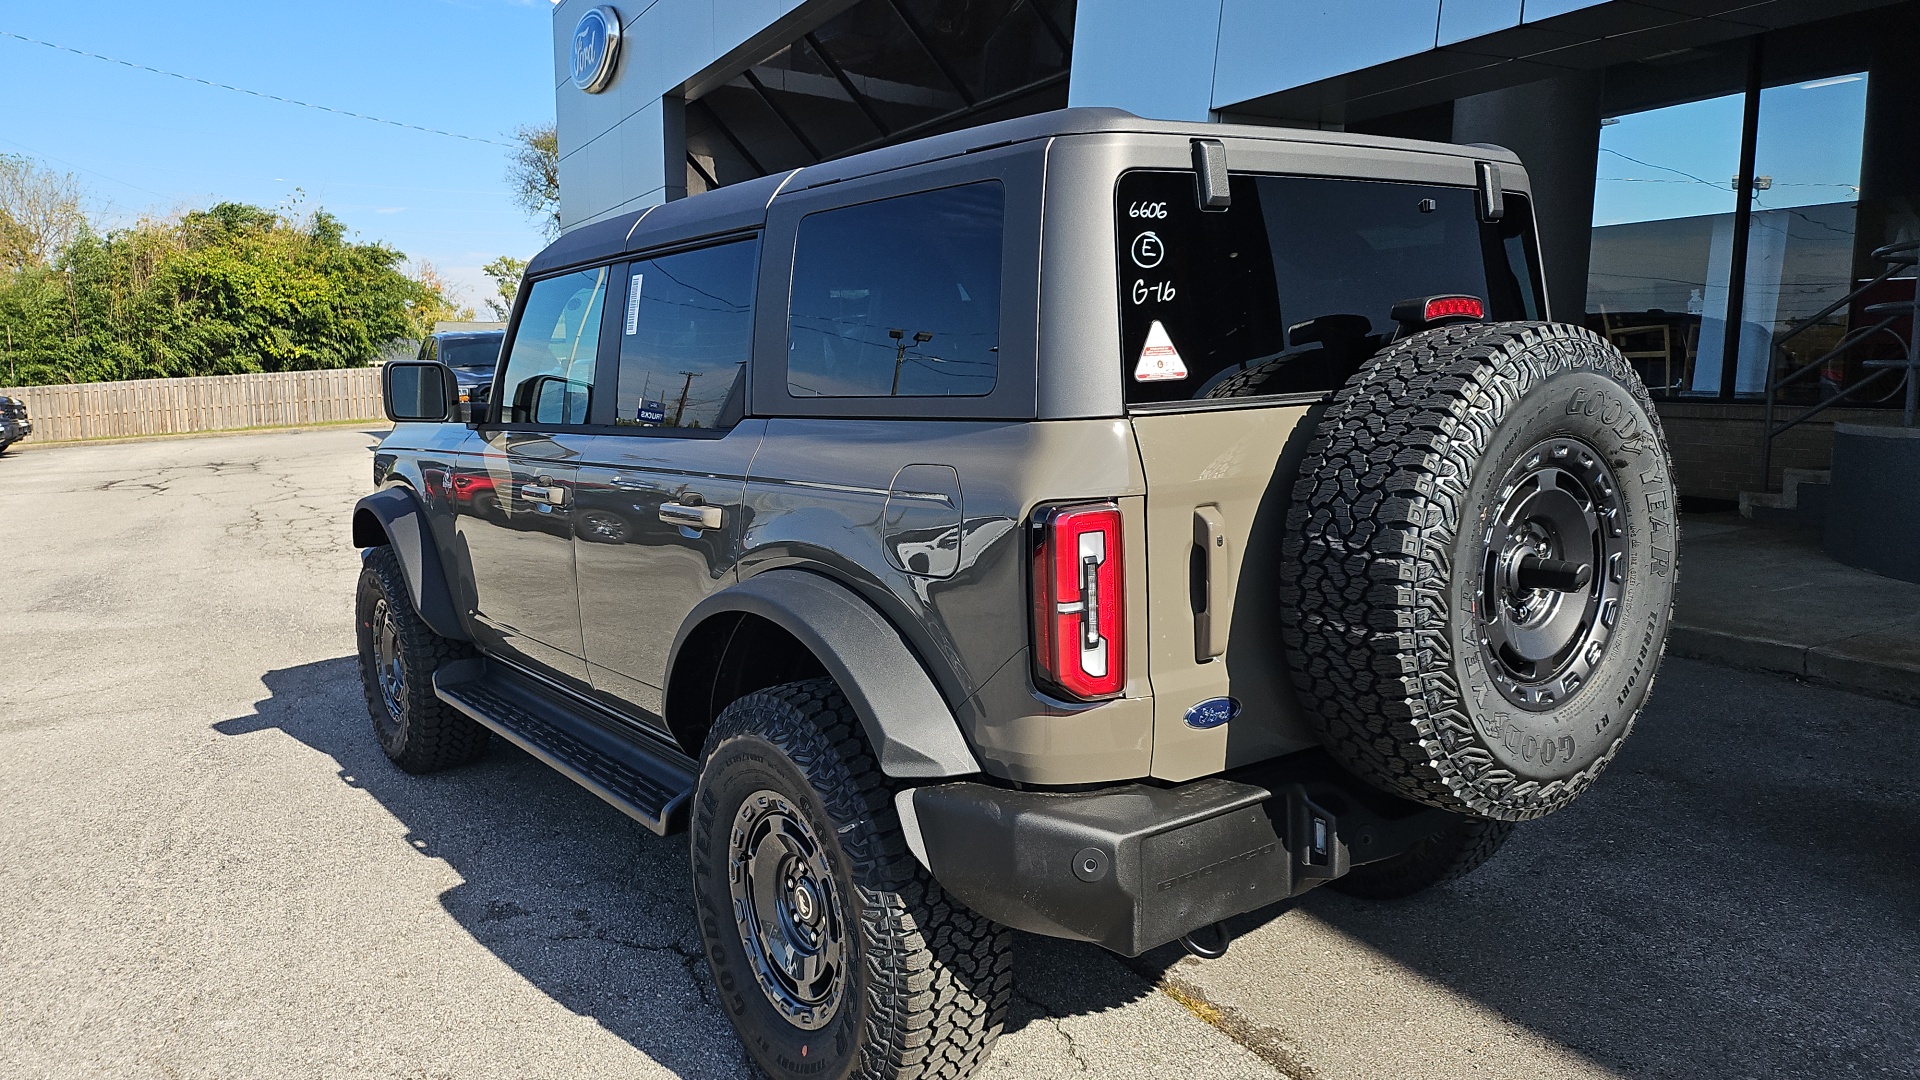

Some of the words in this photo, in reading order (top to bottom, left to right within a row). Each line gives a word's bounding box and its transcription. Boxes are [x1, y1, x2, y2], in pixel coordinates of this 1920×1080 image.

[574, 26, 596, 77] Ford
[1142, 238, 1157, 256] E
[1132, 279, 1176, 305] G-16
[1616, 610, 1659, 710] TERRITORY
[1198, 705, 1231, 724] Ford
[1594, 713, 1610, 737] RT
